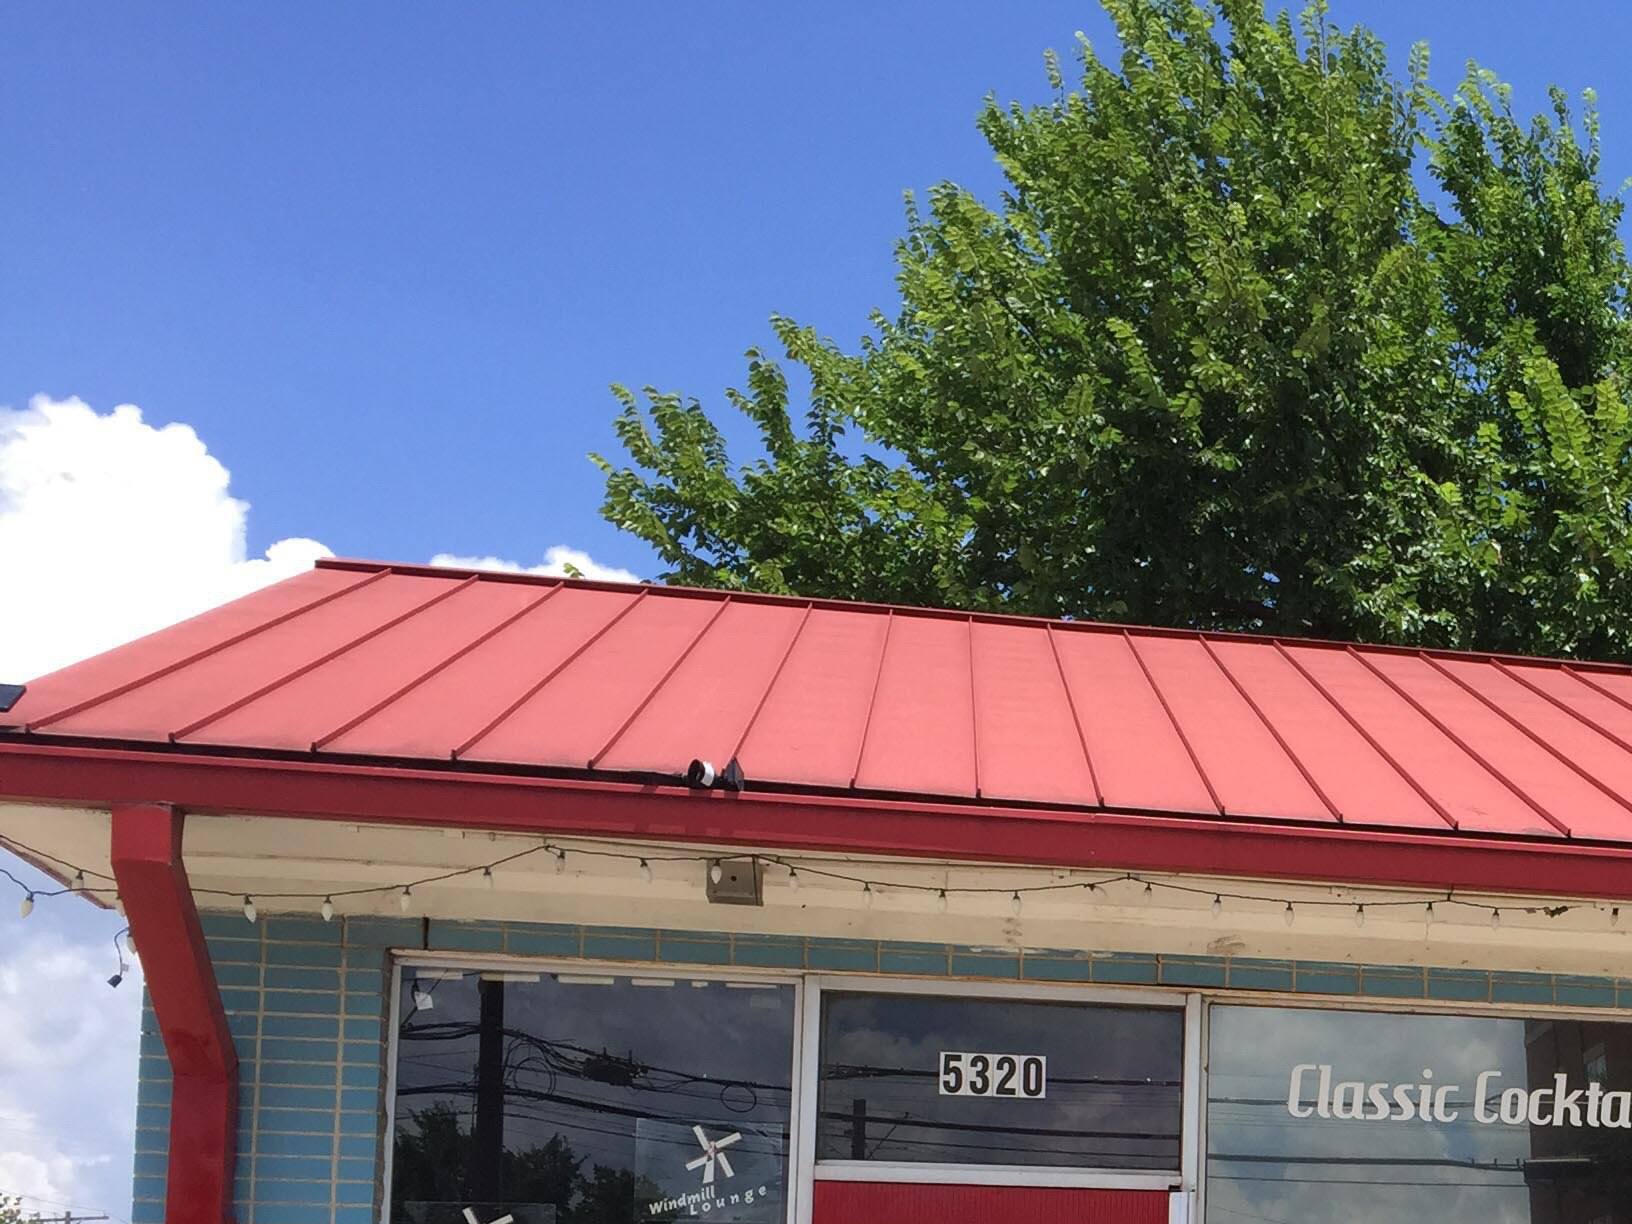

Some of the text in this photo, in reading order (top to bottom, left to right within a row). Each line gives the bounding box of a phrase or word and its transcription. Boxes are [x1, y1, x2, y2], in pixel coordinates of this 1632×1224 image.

[943, 1054, 1042, 1096] 5320
[1287, 1064, 1460, 1123] Classic
[649, 1185, 715, 1215] Windmill
[690, 1185, 767, 1216] Lounge
